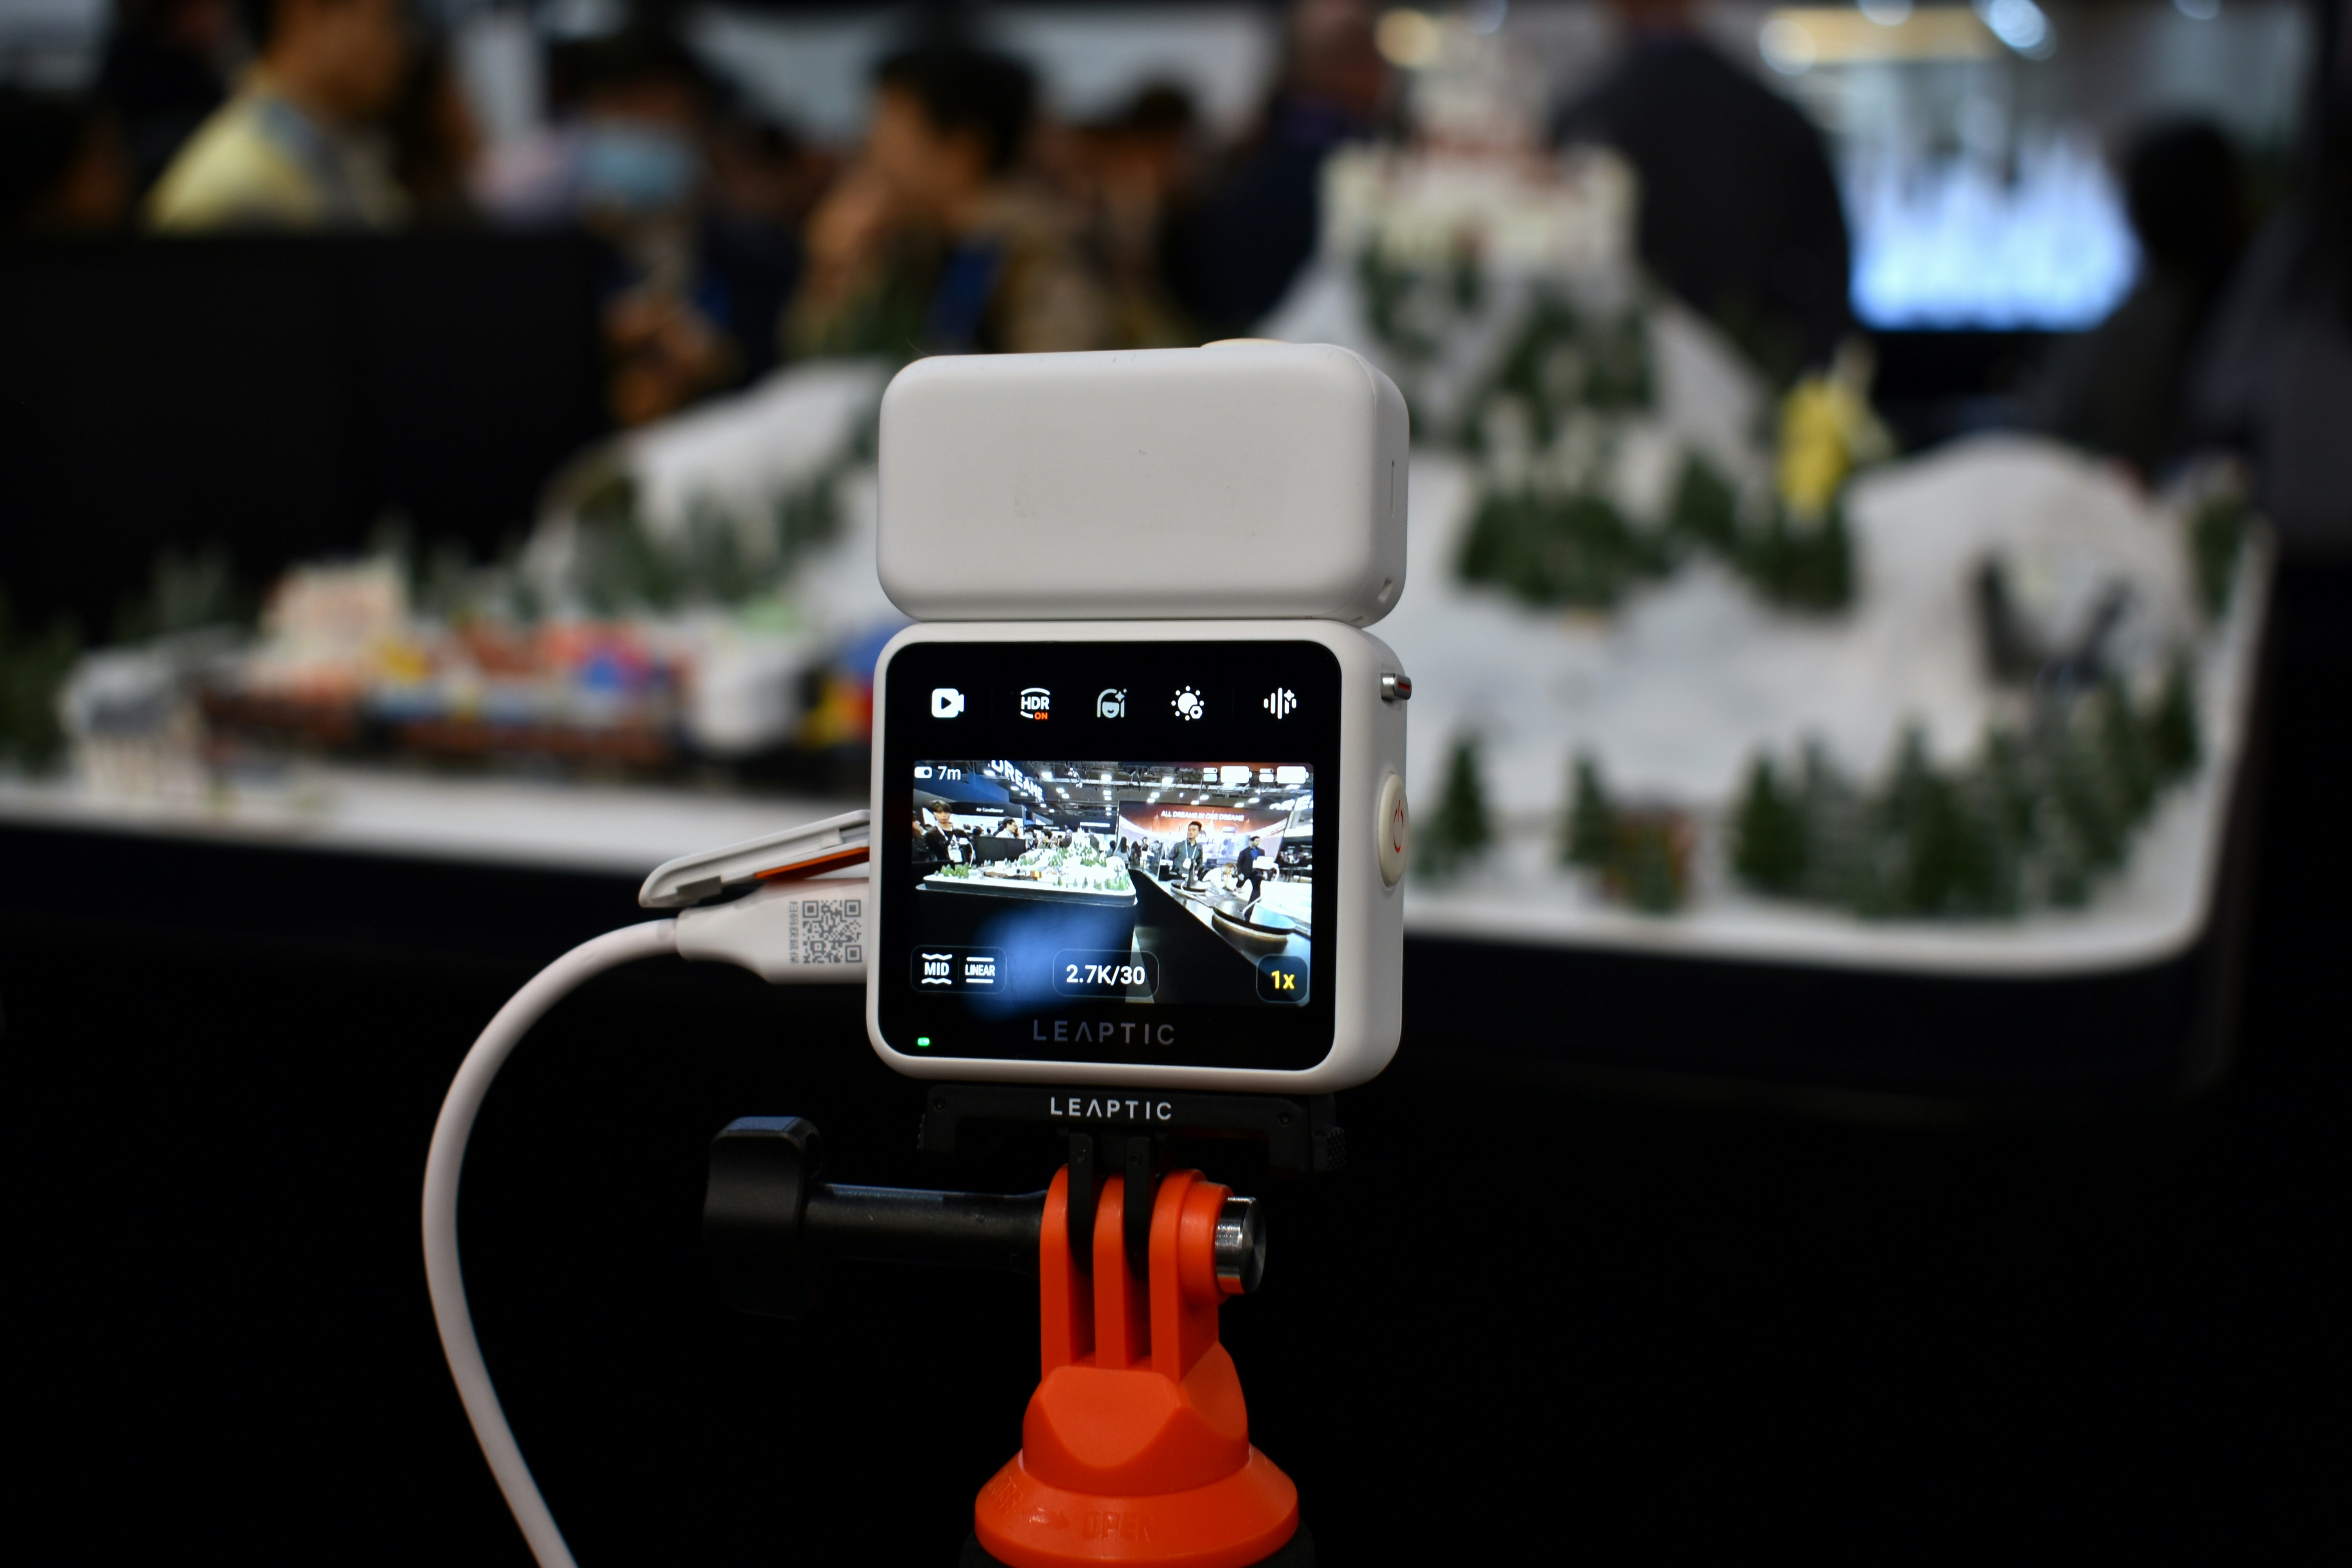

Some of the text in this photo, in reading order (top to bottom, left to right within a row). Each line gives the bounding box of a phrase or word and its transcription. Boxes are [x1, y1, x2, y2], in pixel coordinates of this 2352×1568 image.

[1021, 696, 1049, 710] HDR
[1034, 711, 1048, 720] ON
[938, 766, 961, 780] 7m
[924, 962, 949, 976] MID
[965, 964, 995, 976] LINEAR
[1066, 964, 1145, 985] 2.7K/30
[1271, 970, 1295, 989] 1x
[1033, 1020, 1174, 1045] LEAPTIC
[1051, 1097, 1171, 1120] LEAPTIC
